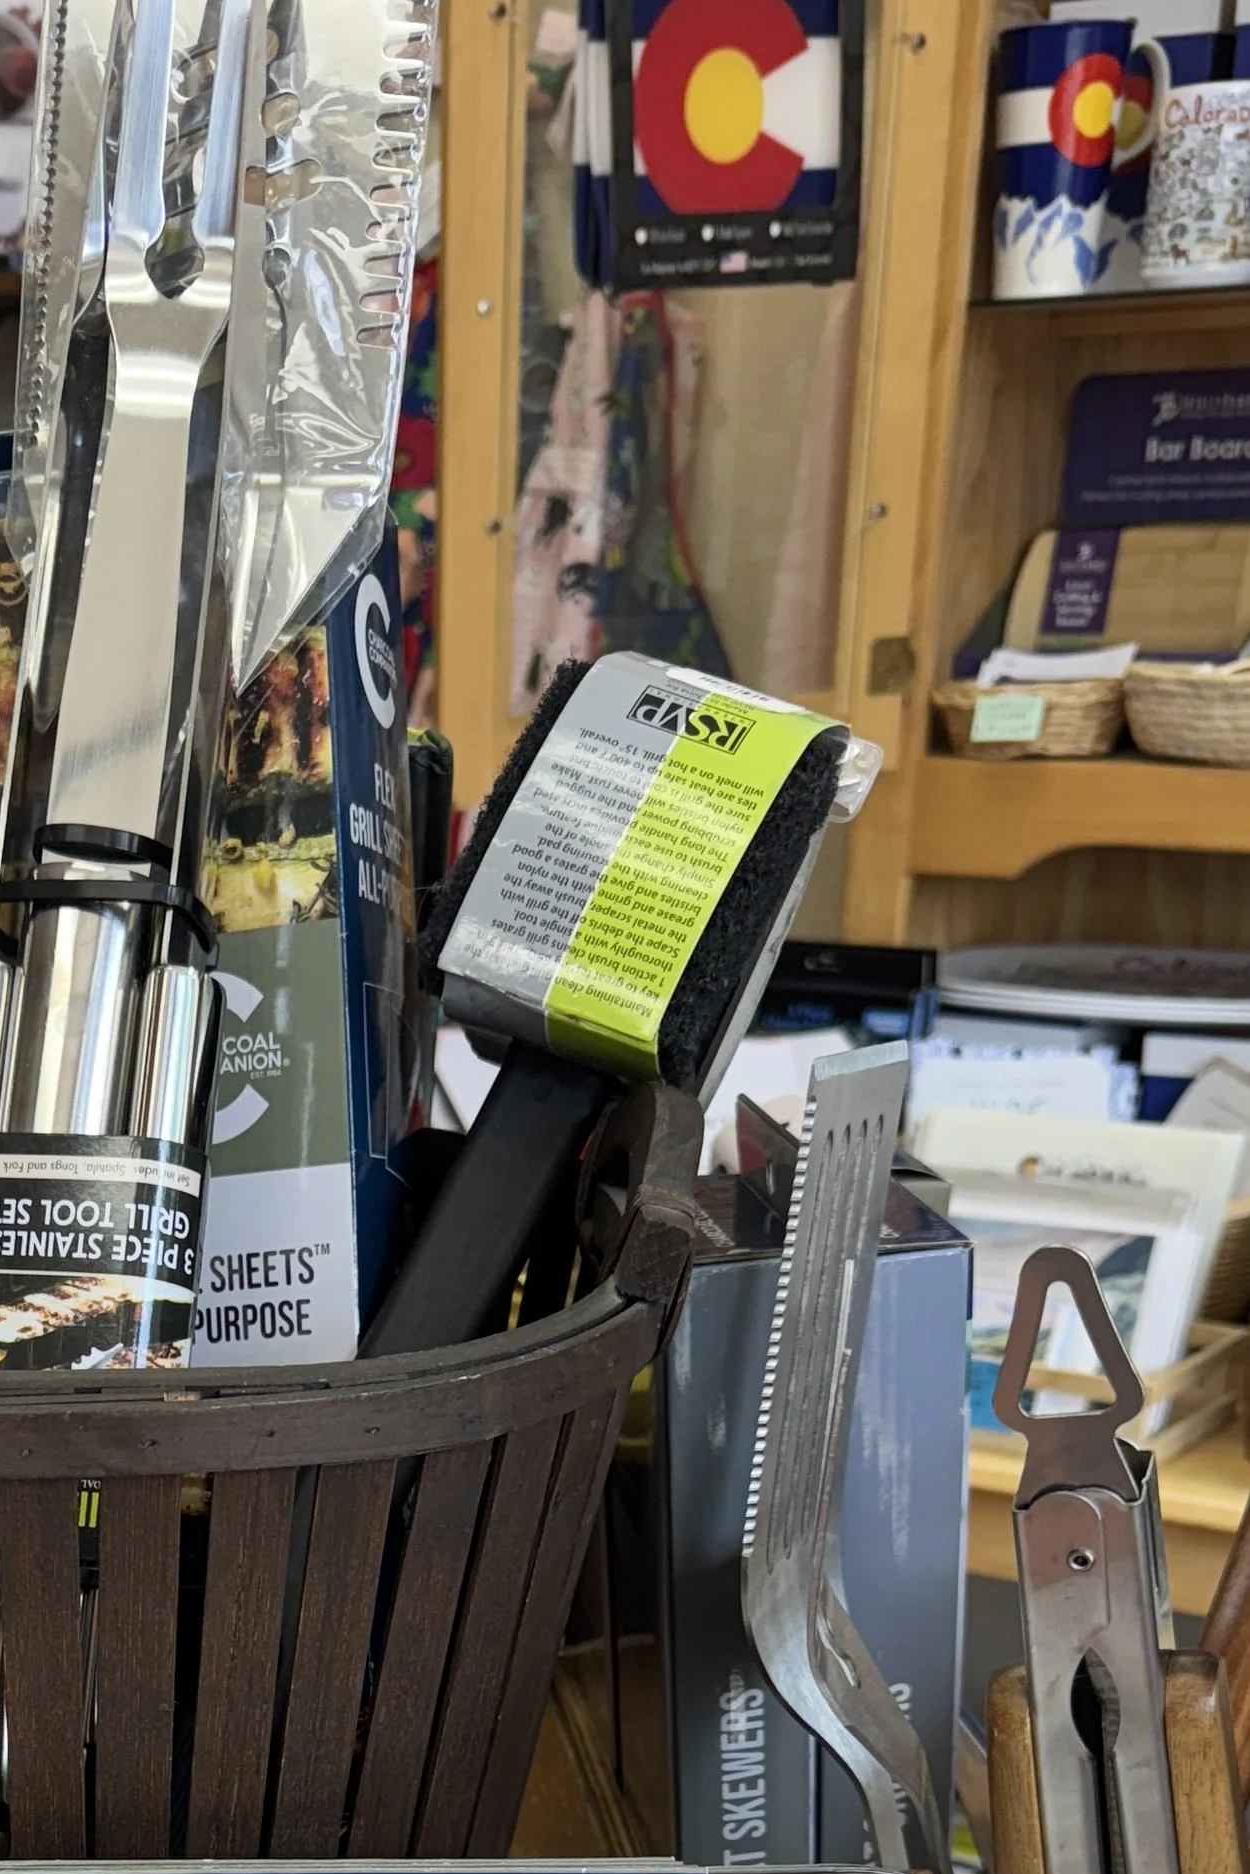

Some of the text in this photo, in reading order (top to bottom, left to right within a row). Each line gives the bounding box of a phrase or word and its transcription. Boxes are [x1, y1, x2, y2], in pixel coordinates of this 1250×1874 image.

[631, 695, 747, 752] RSVP
[350, 802, 383, 856] GRILL
[490, 916, 526, 938] grates
[499, 887, 680, 959] Scape the debris off the grill with
[538, 916, 574, 938] single
[525, 928, 550, 947] grill
[549, 937, 586, 960] cleans
[582, 932, 609, 950] with
[586, 951, 620, 972] brush
[609, 940, 674, 974] thoroughly
[620, 962, 657, 985] action
[222, 1032, 281, 1056] COAL
[2, 1160, 24, 1172] Fork
[27, 1161, 48, 1172] and
[50, 1161, 79, 1174] Tongs
[85, 1162, 126, 1176] Spatula,
[178, 1171, 191, 1187] Set
[41, 1199, 114, 1228] TOOL
[125, 1202, 190, 1240] GRILL
[111, 1238, 178, 1270] PIECE
[183, 1252, 193, 1275] 3
[719, 1688, 767, 1841] SKEWERS
